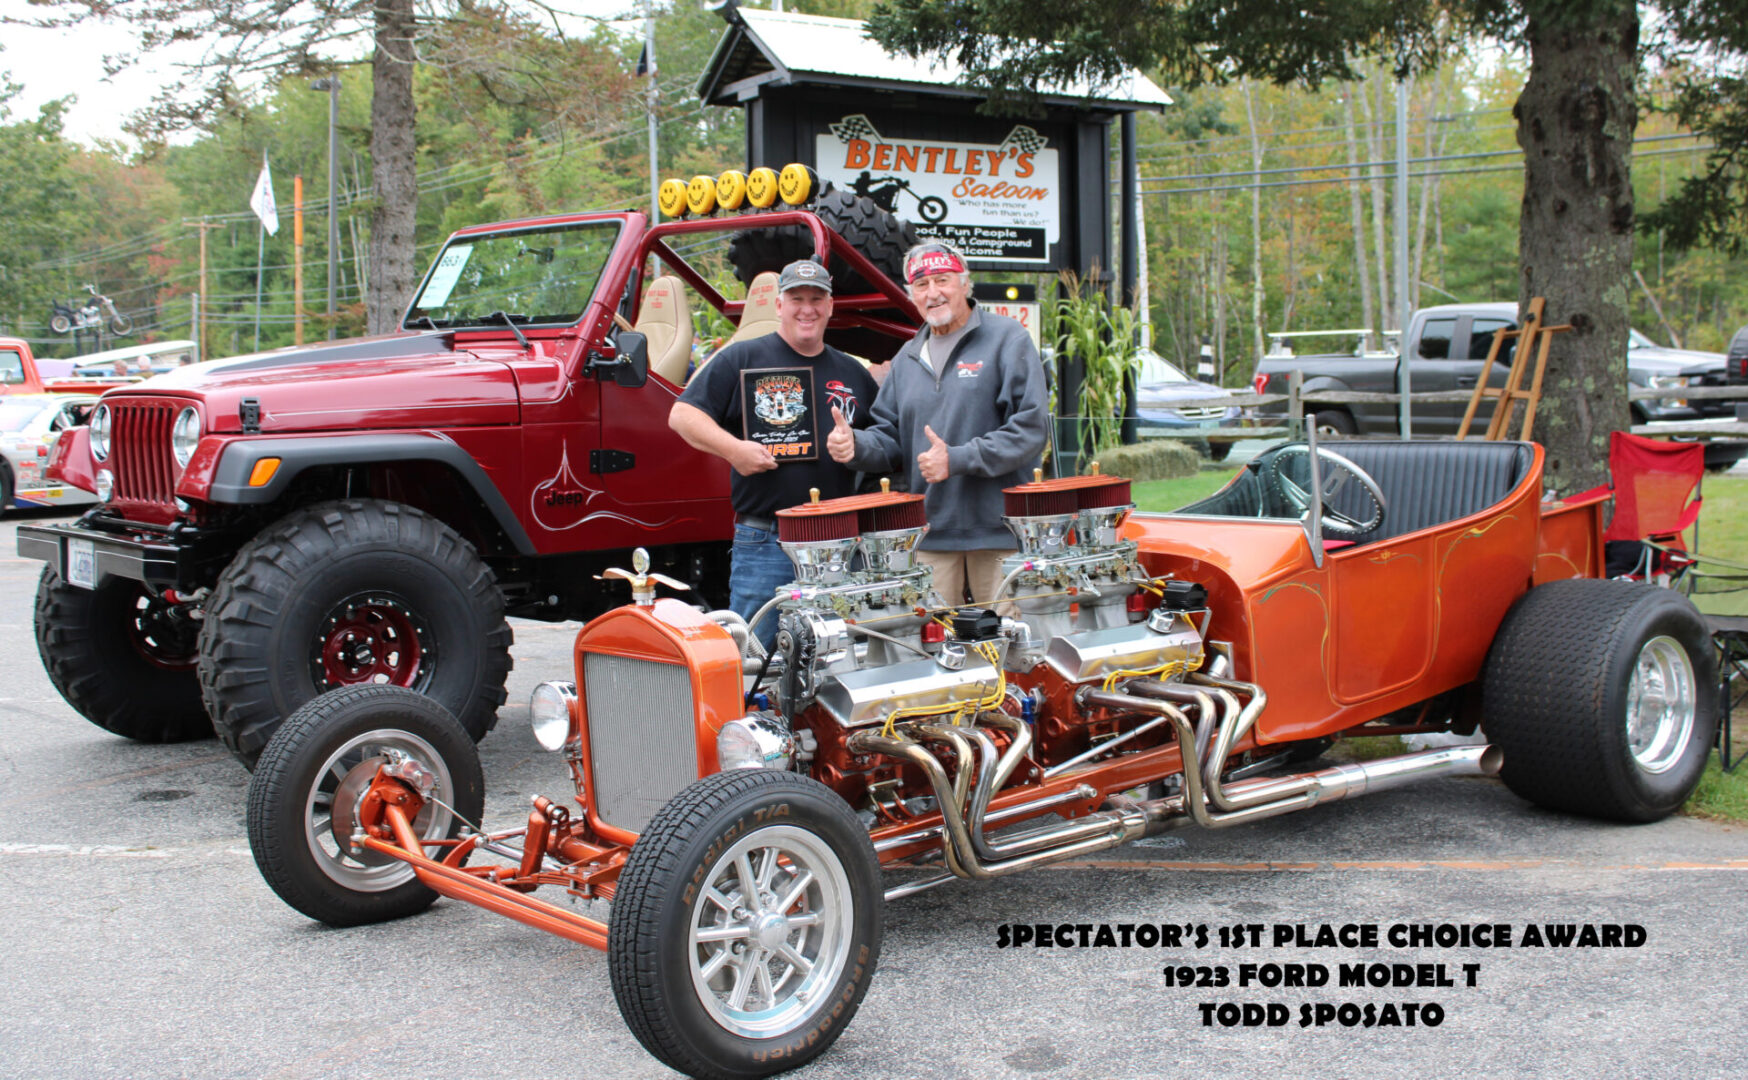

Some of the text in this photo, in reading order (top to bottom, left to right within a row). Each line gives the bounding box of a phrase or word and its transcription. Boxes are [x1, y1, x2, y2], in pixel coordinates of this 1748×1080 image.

[844, 139, 1035, 178] BENTLEY'S
[952, 177, 1049, 200] Saloon
[1000, 209, 1021, 217] than
[945, 226, 971, 236] Fun
[974, 227, 1018, 239] People
[958, 236, 966, 245] &
[969, 237, 1032, 249] Campground
[957, 245, 1004, 256] elcome
[767, 442, 813, 457] IRST
[544, 488, 583, 506] Jeep
[683, 803, 790, 905] Radial T/A
